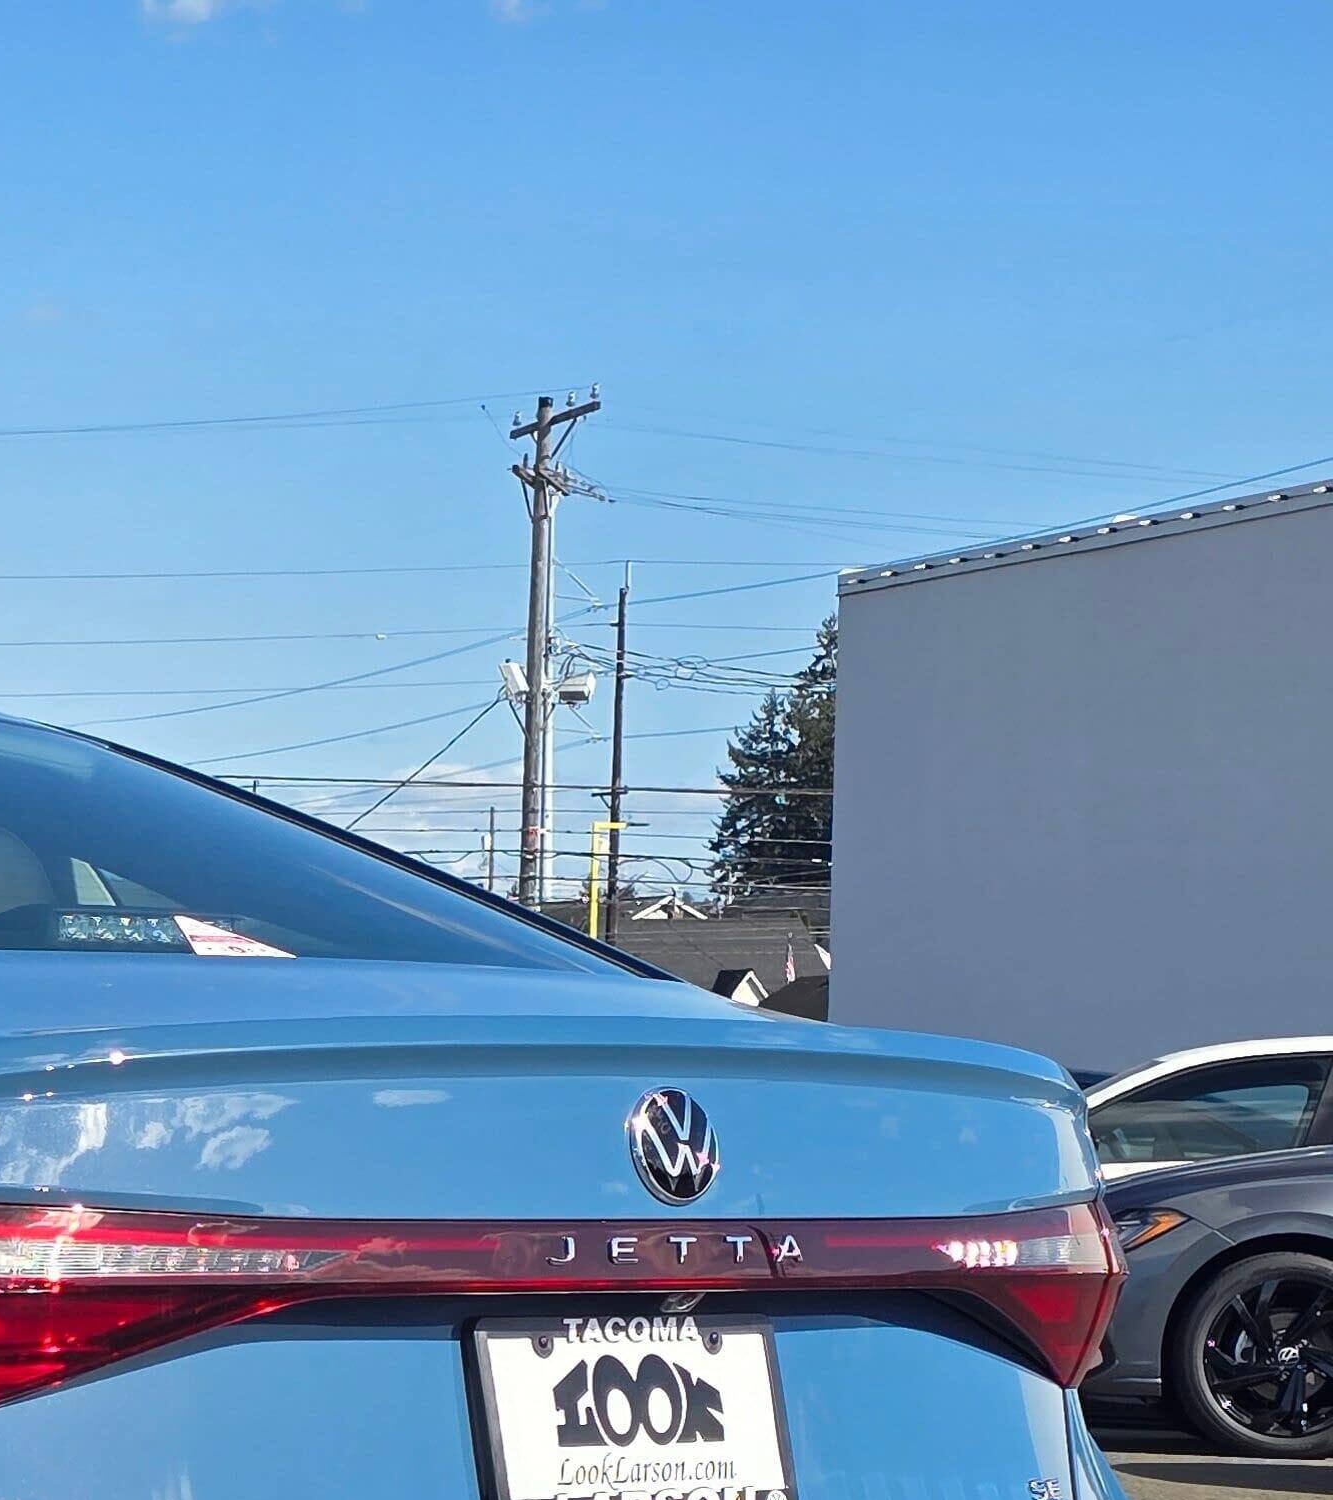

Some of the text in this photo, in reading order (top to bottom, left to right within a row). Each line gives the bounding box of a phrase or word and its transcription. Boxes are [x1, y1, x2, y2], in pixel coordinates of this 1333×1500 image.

[545, 1235, 804, 1266] JETTA
[563, 1316, 700, 1344] TACOMA
[553, 1354, 725, 1447] LOOK
[557, 1452, 737, 1488] LookLarson.com
